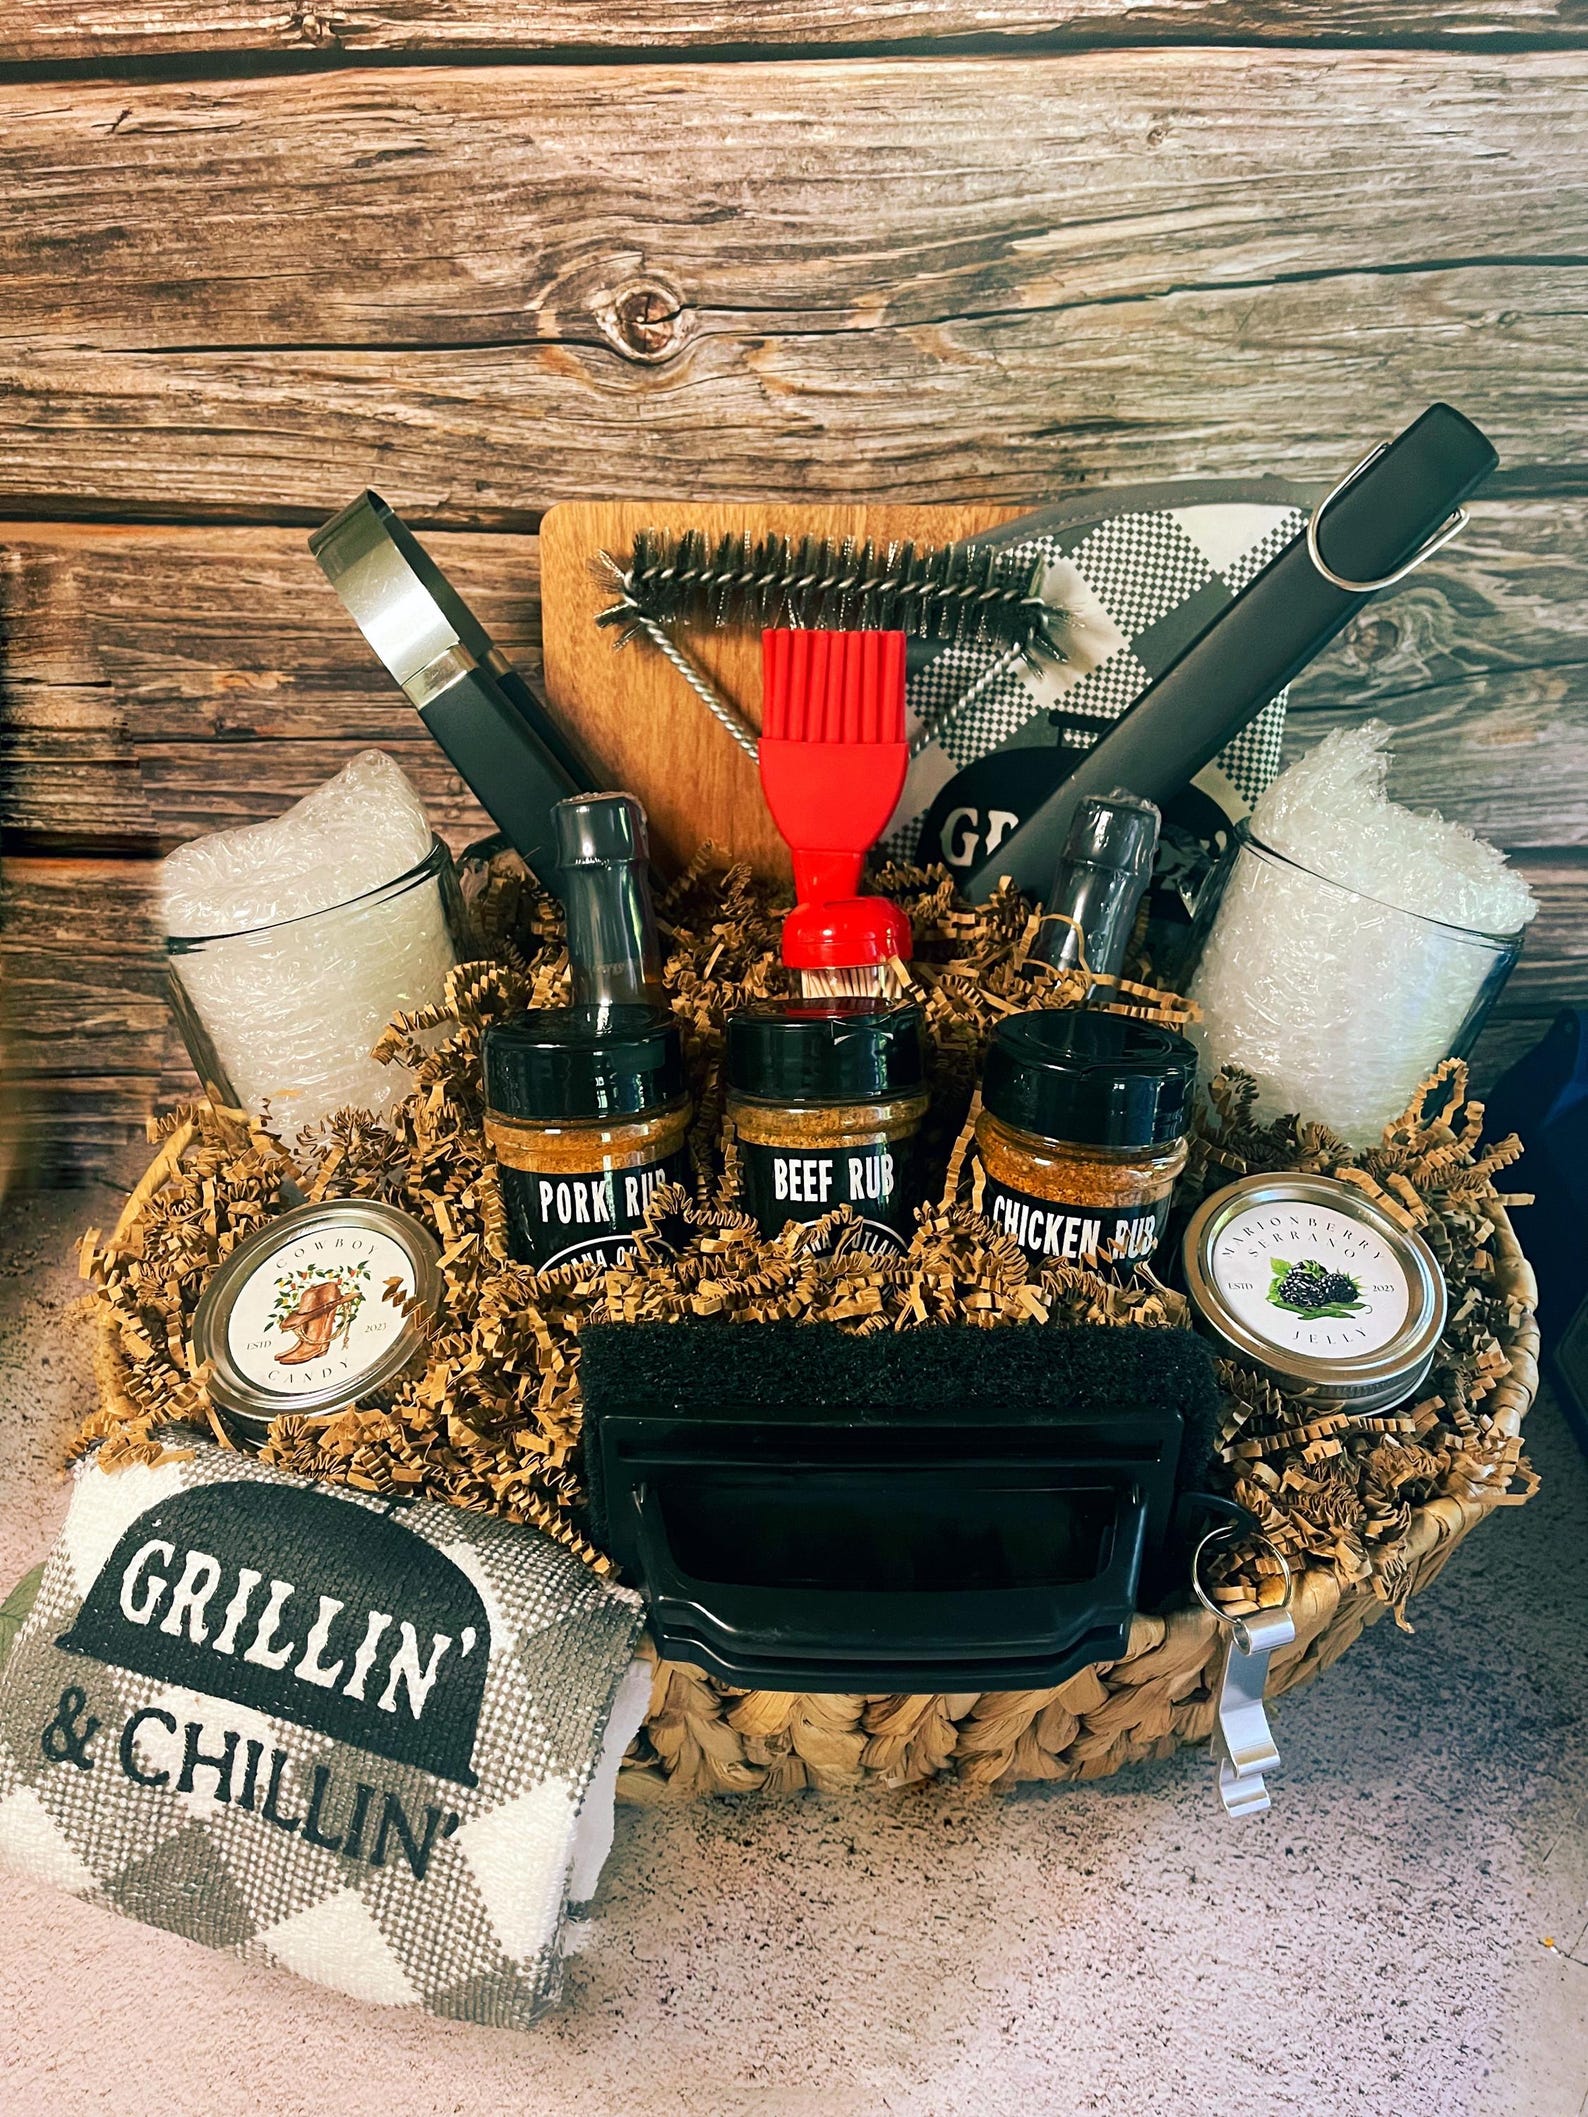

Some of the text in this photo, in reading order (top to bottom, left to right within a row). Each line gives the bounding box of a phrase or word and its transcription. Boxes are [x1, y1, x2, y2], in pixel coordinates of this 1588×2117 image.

[773, 1153, 895, 1203] BEEF RUB
[538, 1180, 611, 1224] PORK
[992, 1195, 1156, 1260] CHICKEN RUB
[1221, 1216, 1384, 1259] MARIONBERRY
[1248, 1230, 1356, 1259] SERRANO
[275, 1237, 380, 1270] COWBOY
[1227, 1281, 1395, 1293] ESTD 2023
[246, 1340, 272, 1351] ESTD
[1292, 1327, 1368, 1345] JELLY
[267, 1359, 349, 1384] CANDY
[118, 1538, 478, 1720] GRILLIN'
[40, 1685, 462, 1881] & CHILLIN'
